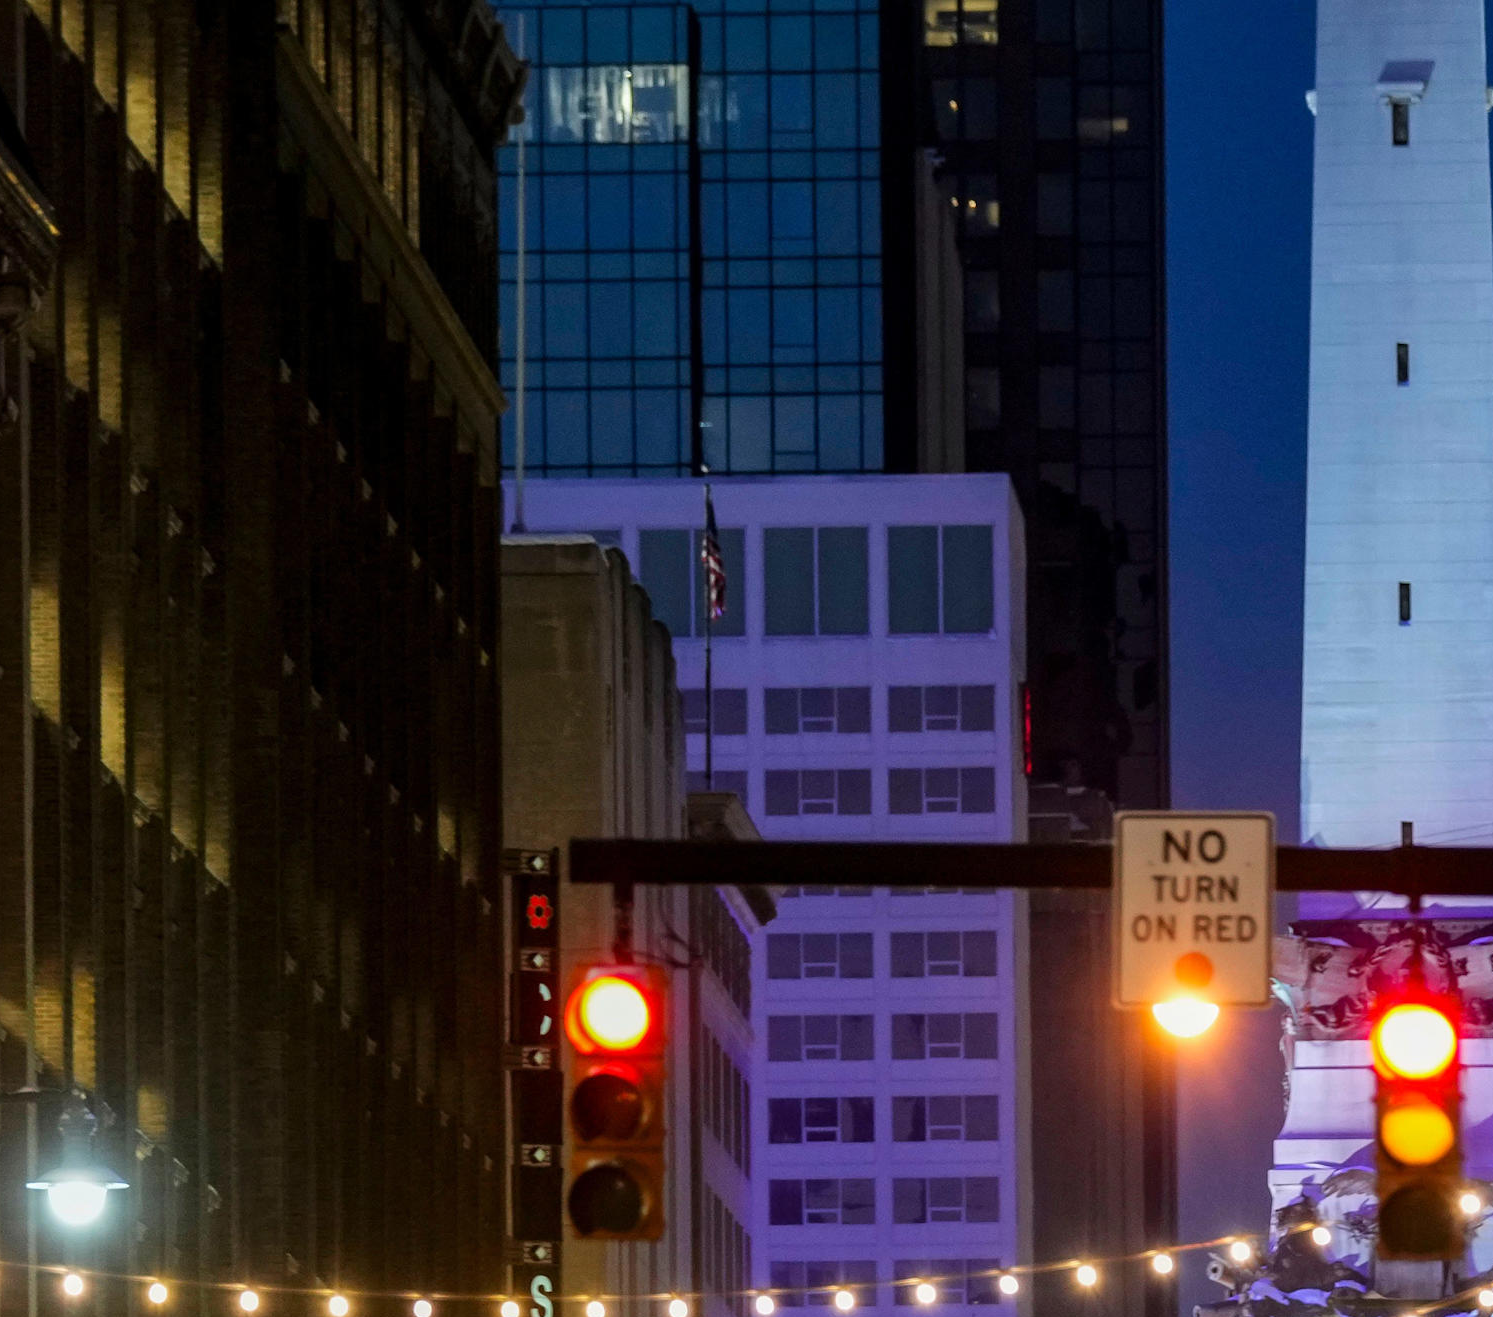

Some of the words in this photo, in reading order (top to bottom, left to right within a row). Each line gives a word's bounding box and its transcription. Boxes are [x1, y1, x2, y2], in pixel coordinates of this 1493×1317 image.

[1163, 831, 1226, 863] NO
[1152, 876, 1239, 903] TURN
[1132, 916, 1181, 942] ON
[1192, 915, 1257, 942] RED
